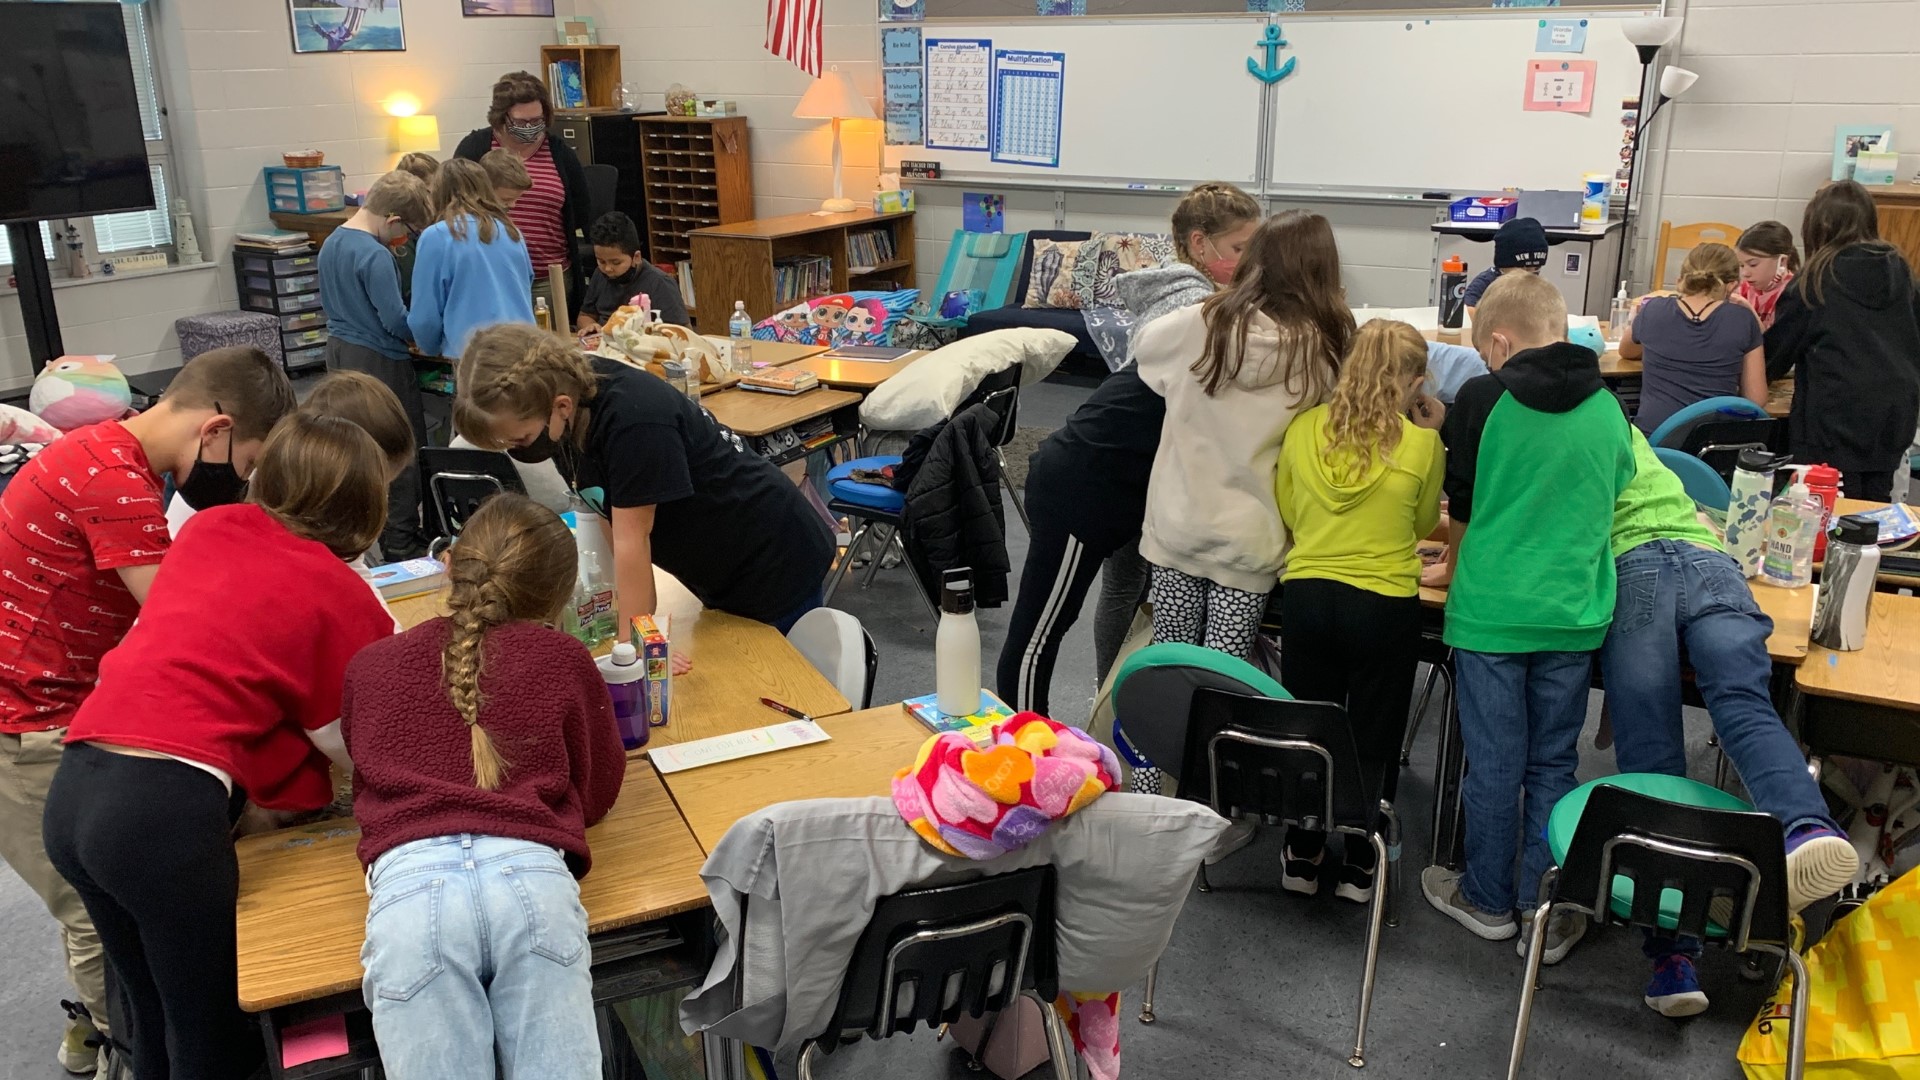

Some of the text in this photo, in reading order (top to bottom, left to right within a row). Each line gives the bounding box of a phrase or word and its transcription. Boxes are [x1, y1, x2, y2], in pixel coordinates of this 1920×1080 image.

[1008, 55, 1051, 64] Multiplication
[1515, 252, 1547, 261] NEW YORK
[1453, 283, 1465, 298] G
[87, 514, 157, 525] Champion
[26, 522, 78, 549] Champion
[1770, 540, 1792, 554] HAND
[2, 569, 50, 594] Champion
